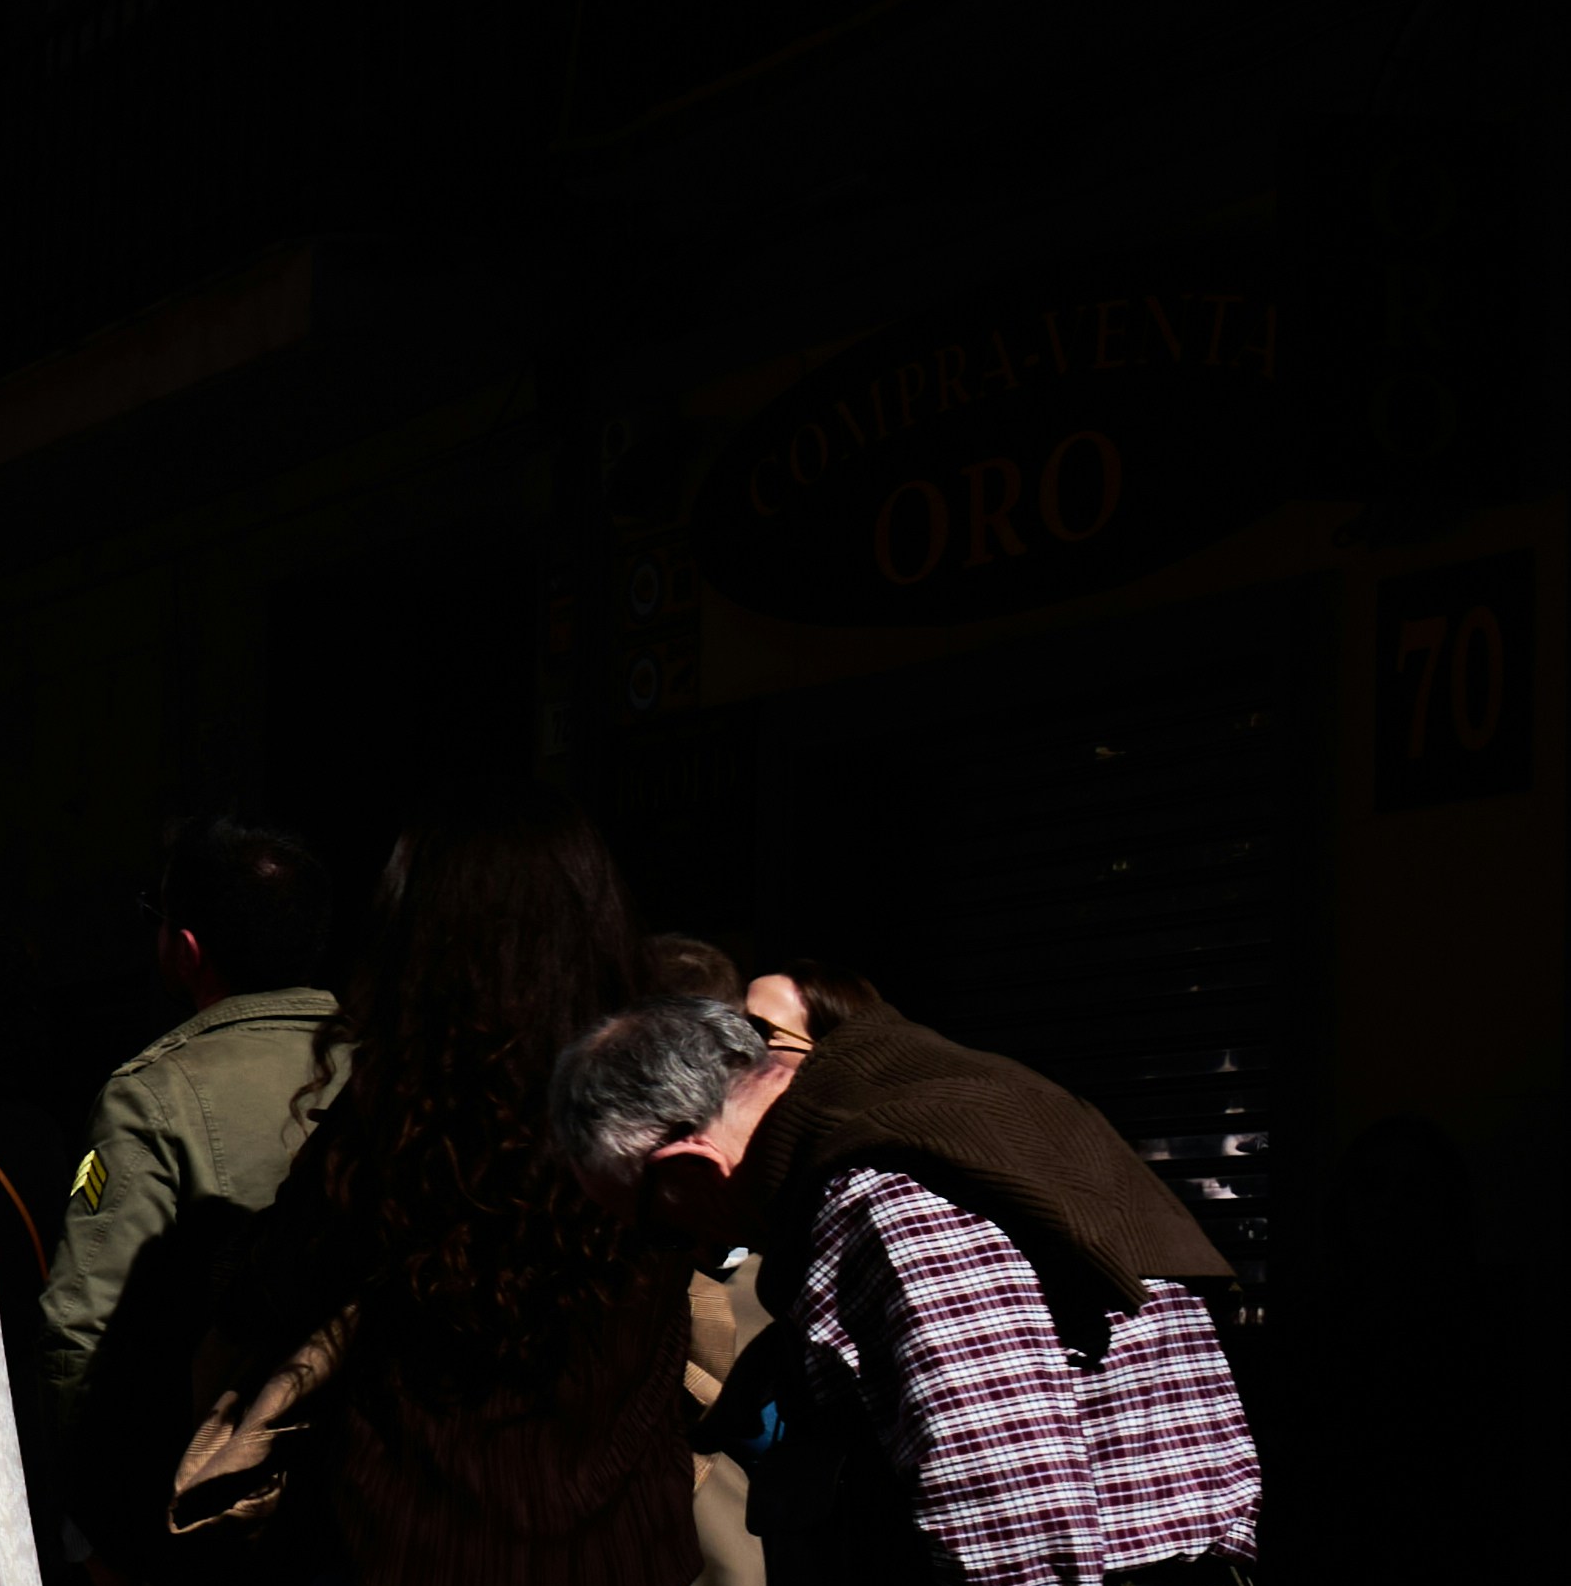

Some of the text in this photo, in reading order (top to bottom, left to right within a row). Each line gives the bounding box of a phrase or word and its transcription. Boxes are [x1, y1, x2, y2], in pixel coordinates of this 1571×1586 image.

[748, 289, 1277, 517] COMPRA-VENTA
[1366, 154, 1458, 461] ORO
[873, 430, 1124, 586] ORO
[1396, 606, 1503, 759] 70
